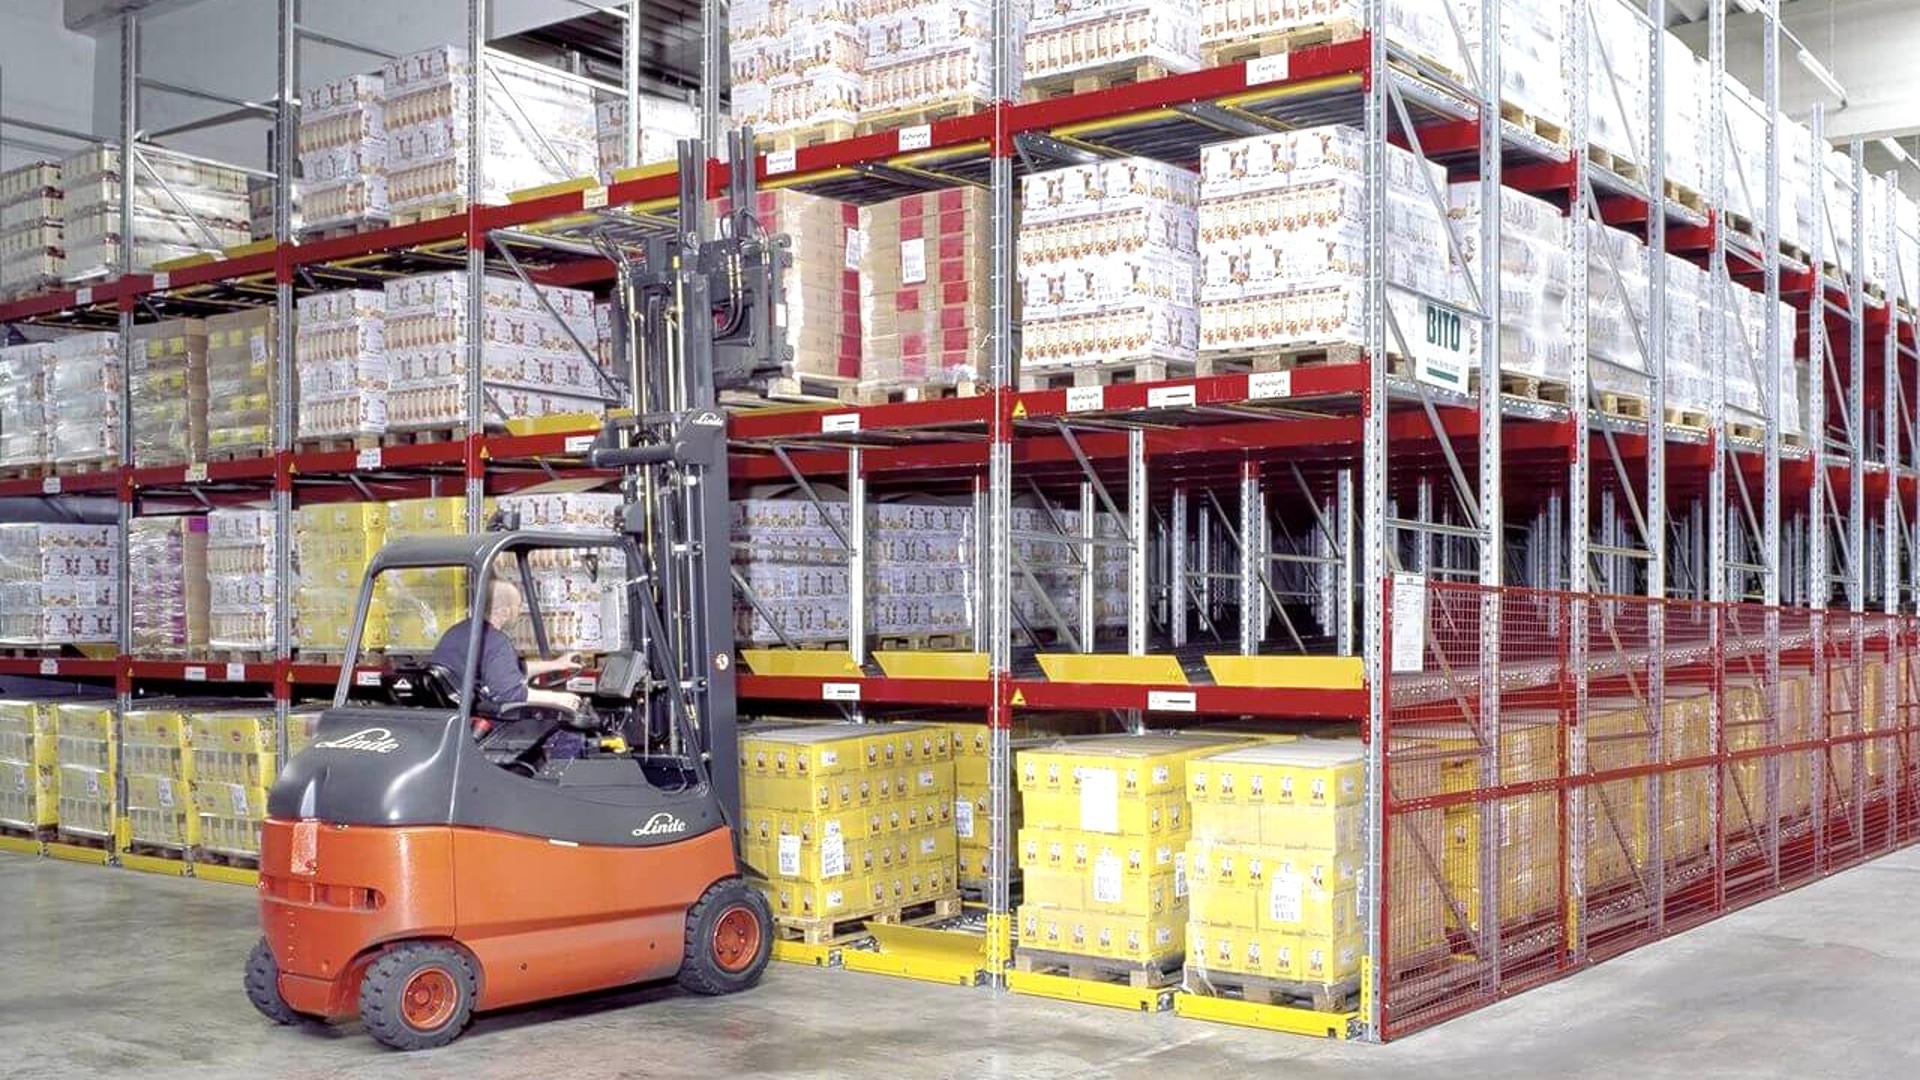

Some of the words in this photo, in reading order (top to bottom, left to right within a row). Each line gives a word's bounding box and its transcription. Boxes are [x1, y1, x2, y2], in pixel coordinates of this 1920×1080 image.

[1427, 305, 1460, 352] BITO
[314, 727, 400, 753] Linde
[632, 813, 687, 836] Linde
